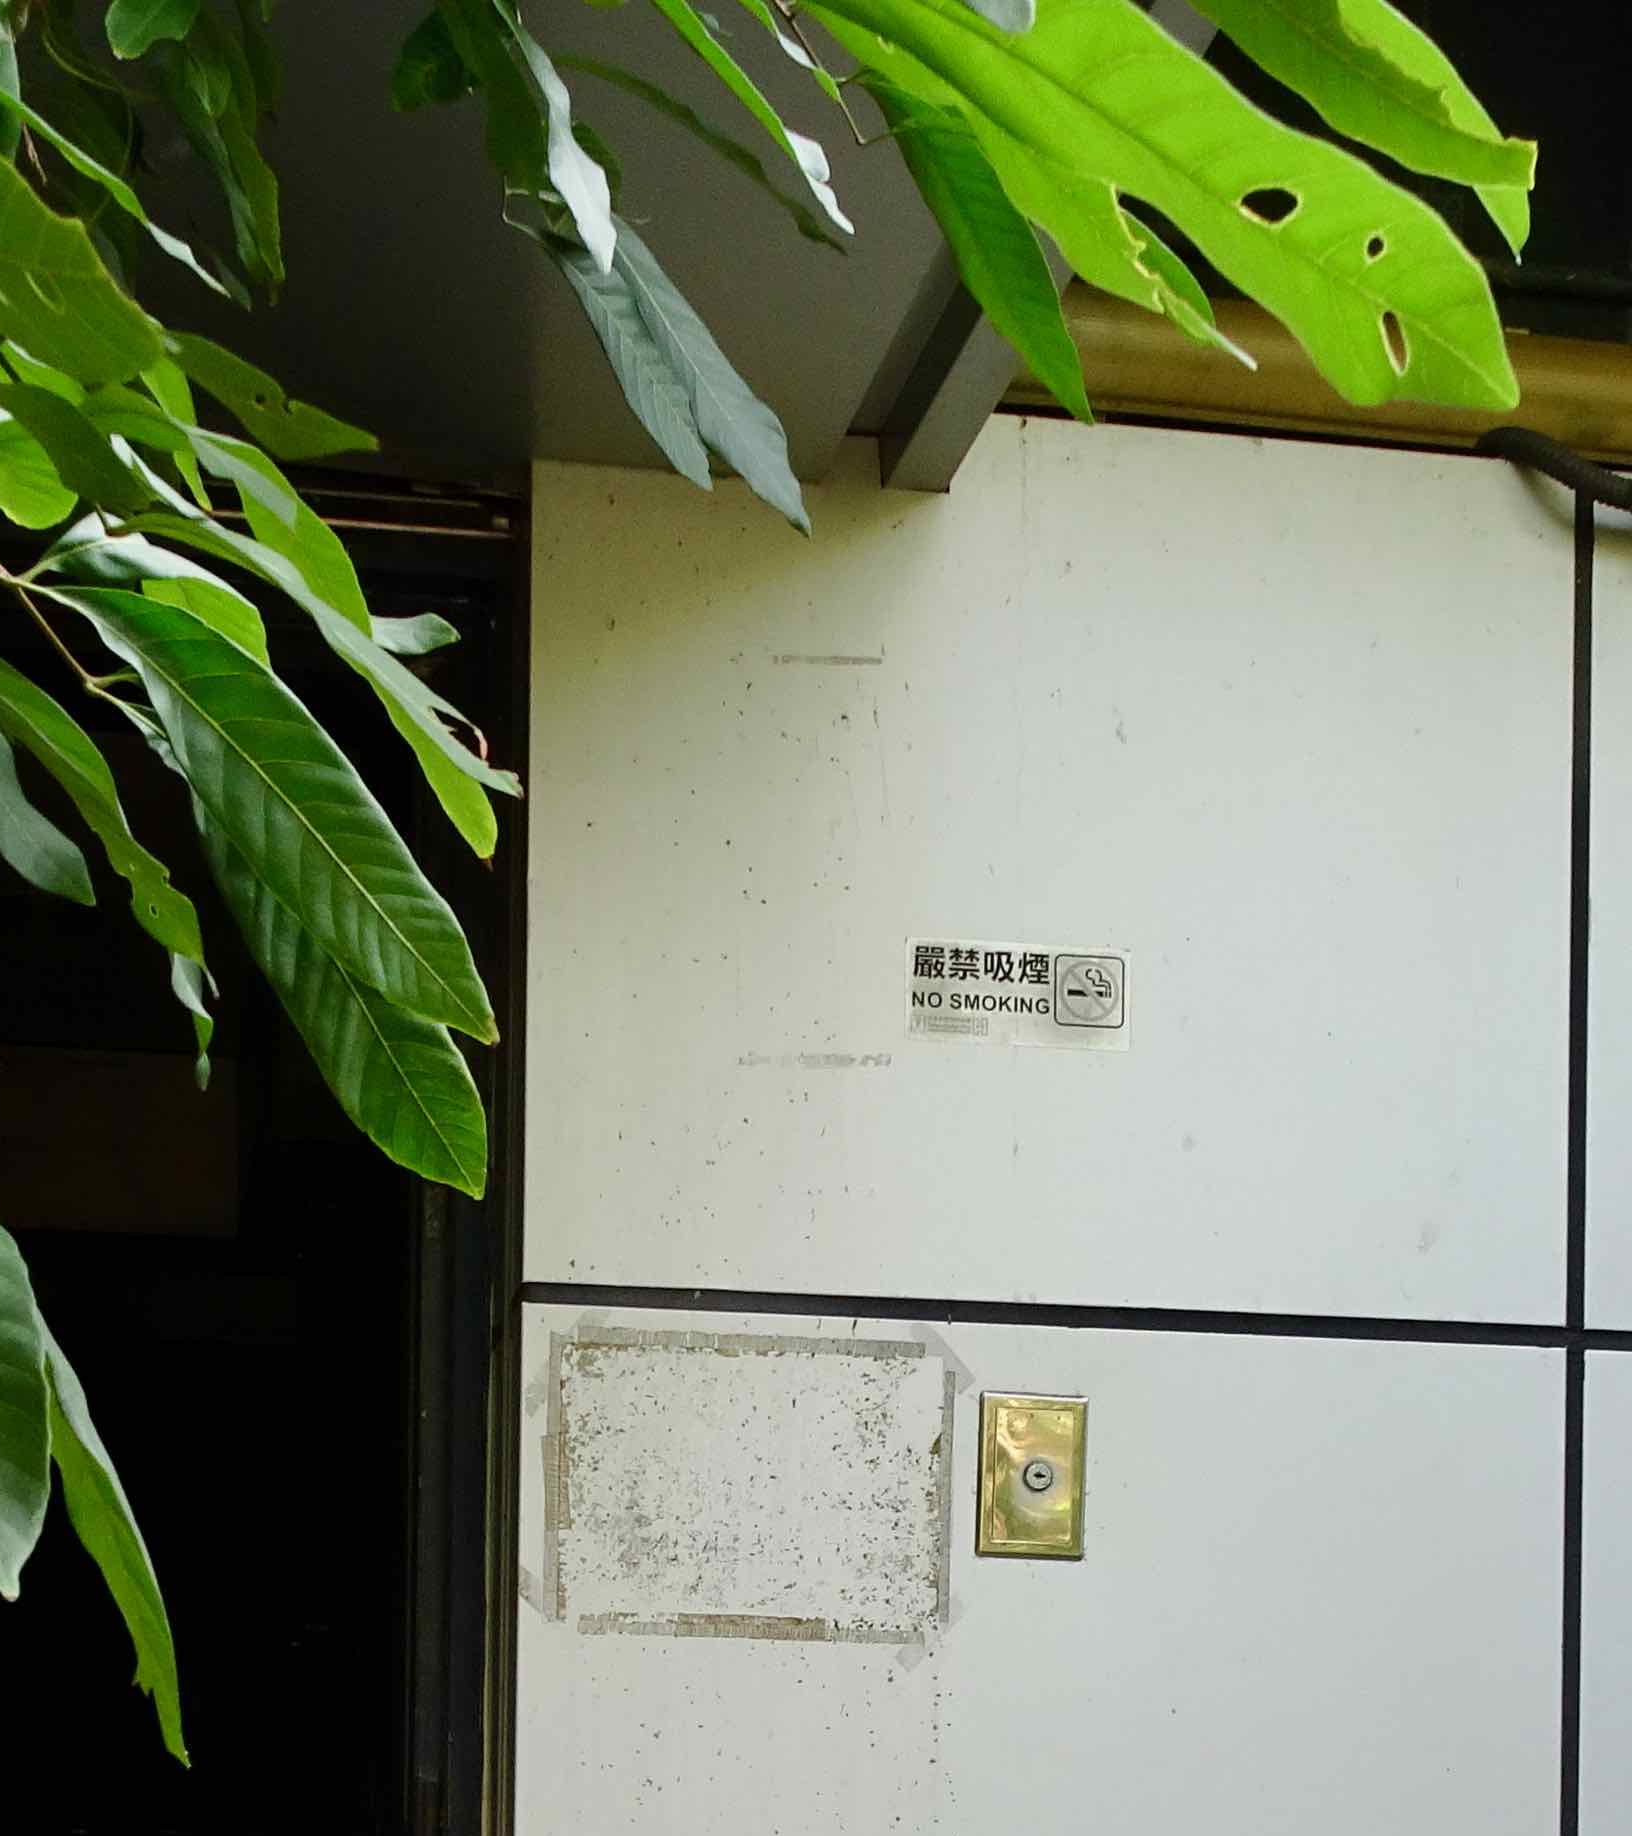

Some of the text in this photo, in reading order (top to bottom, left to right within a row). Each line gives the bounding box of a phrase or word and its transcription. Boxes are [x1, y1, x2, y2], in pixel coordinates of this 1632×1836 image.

[913, 945, 1050, 985] 嚴禁吸煙
[911, 991, 1050, 1015] NO SMOKING
